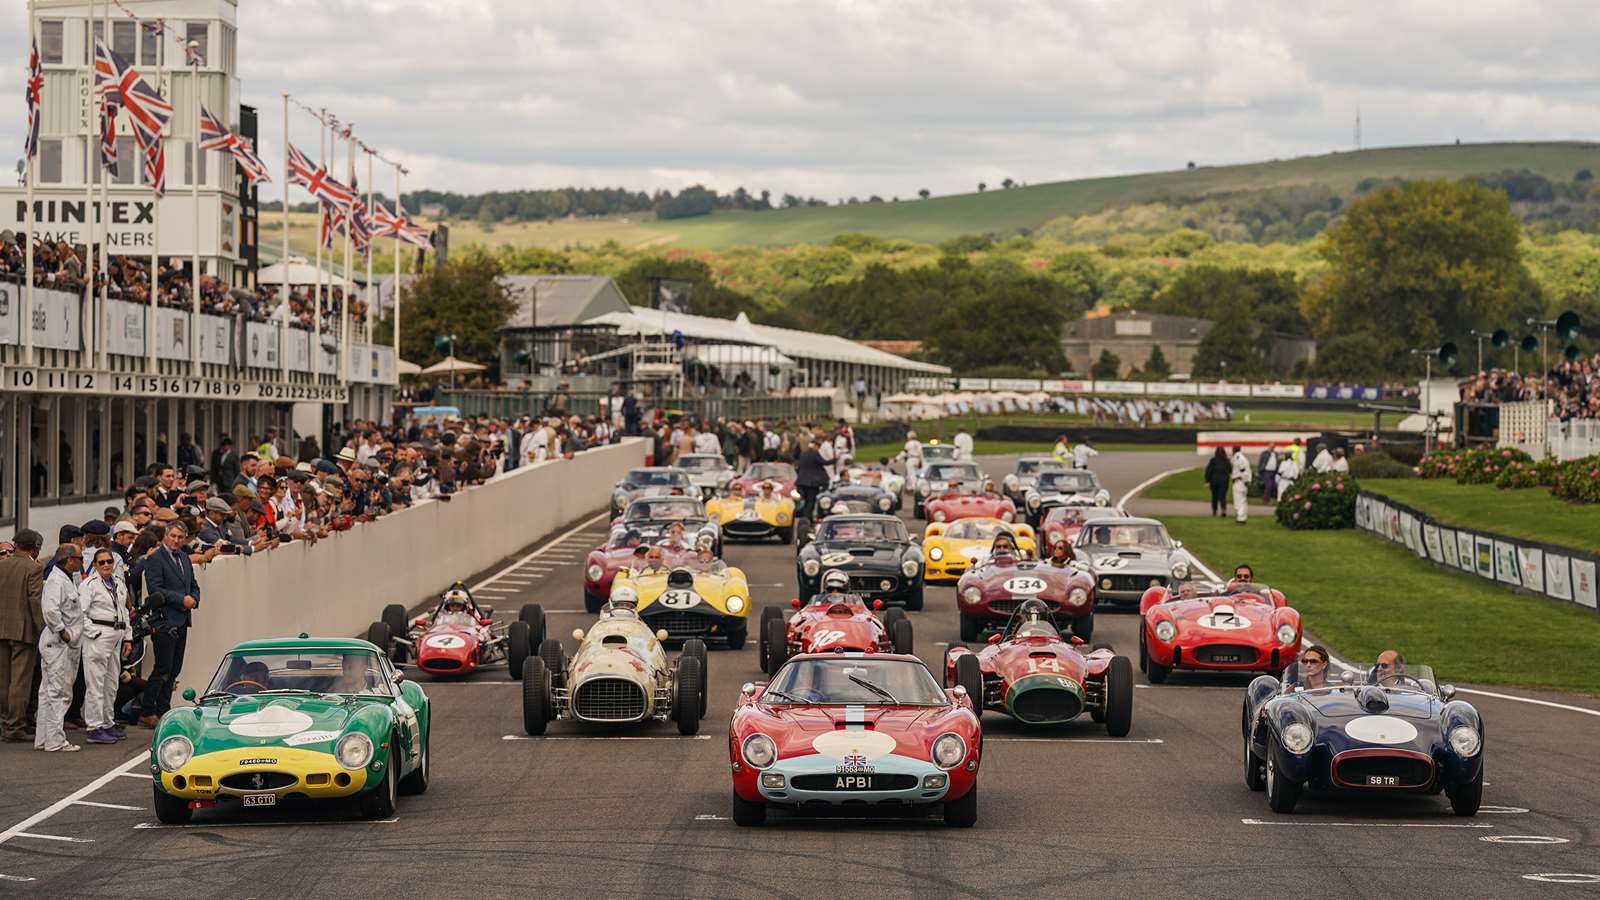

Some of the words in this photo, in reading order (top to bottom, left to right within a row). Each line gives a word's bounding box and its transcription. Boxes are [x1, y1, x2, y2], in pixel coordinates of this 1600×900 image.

[17, 200, 153, 223] MINTEX
[107, 232, 153, 246] NERS
[14, 371, 33, 386] 10
[49, 372, 64, 388] 11
[76, 375, 94, 389] 12
[115, 377, 132, 391] 14
[141, 378, 158, 392] 15
[163, 380, 180, 393] 16
[185, 381, 201, 393] 17
[206, 382, 222, 395] 18
[226, 383, 241, 395] 19
[259, 385, 273, 397] 20
[276, 386, 289, 398] 21
[291, 387, 305, 398] 22
[307, 388, 319, 399] 23
[1009, 579, 1042, 590] 134
[665, 591, 691, 605] 81
[437, 637, 454, 646] 4
[1025, 657, 1065, 673] 14
[1371, 776, 1381, 784] 58
[1384, 776, 1394, 784] TR
[245, 797, 256, 805] 63
[257, 796, 275, 805] GTO
